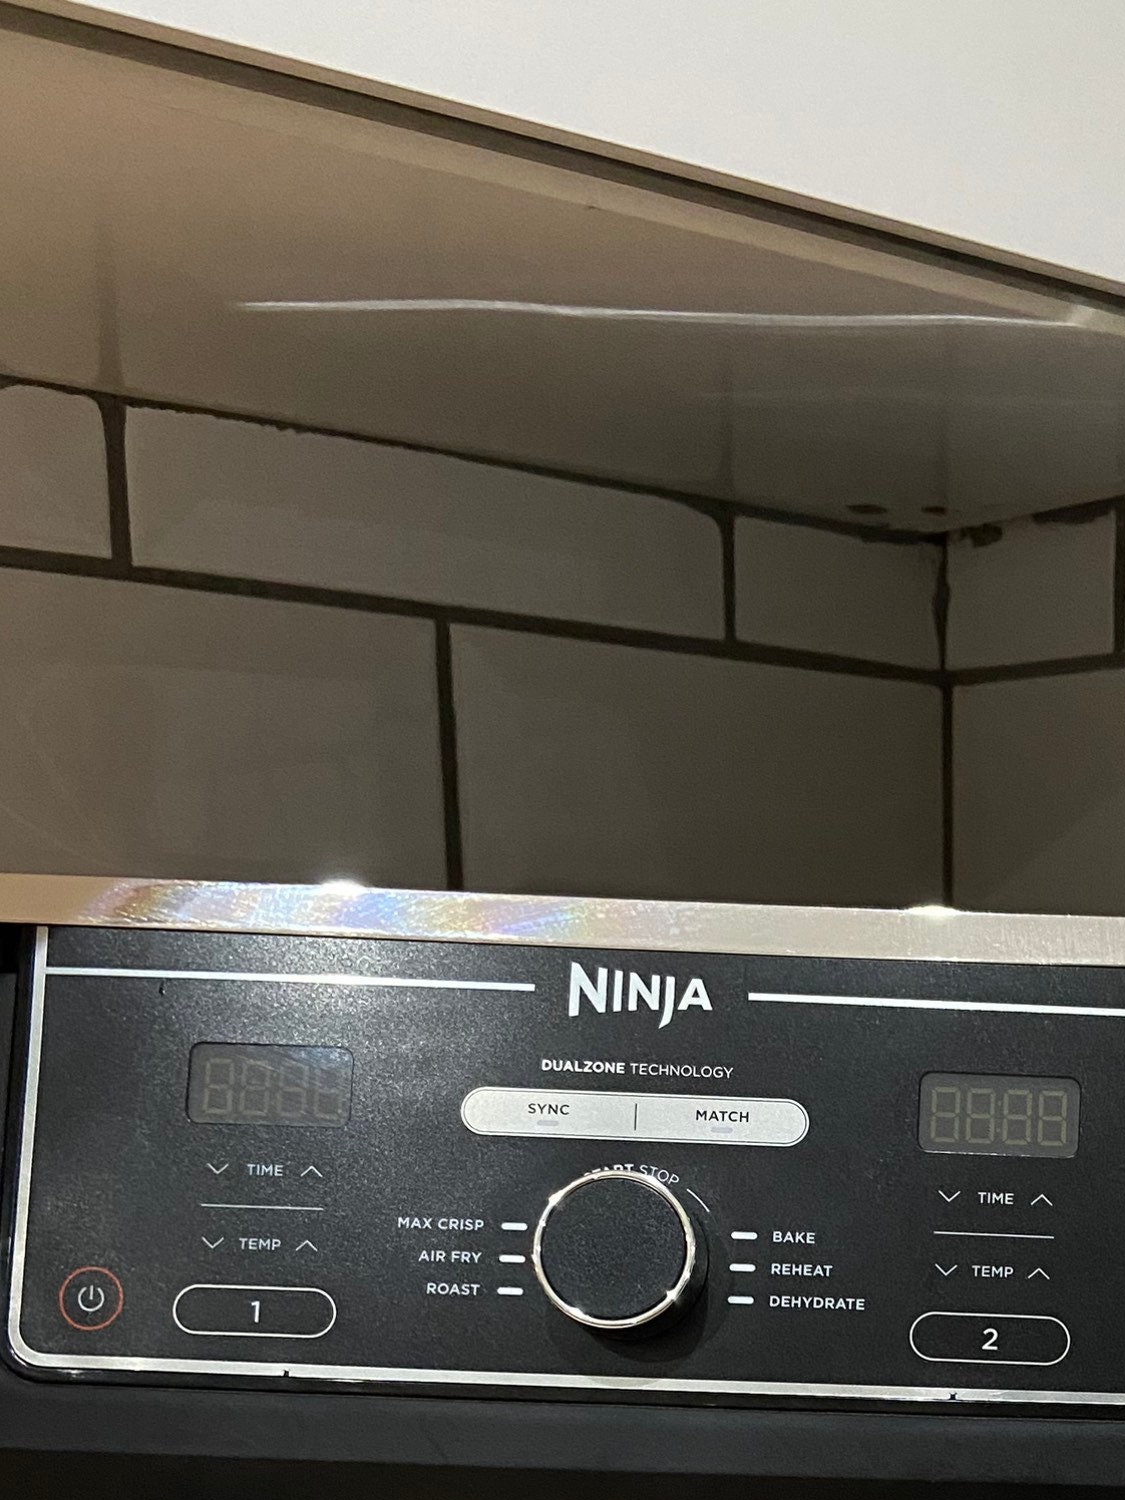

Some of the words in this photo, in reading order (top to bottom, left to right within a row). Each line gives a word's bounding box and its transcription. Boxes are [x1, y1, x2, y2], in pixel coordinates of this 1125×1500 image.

[569, 961, 712, 1029] NINJA
[541, 1058, 626, 1074] DUALZONE
[629, 1062, 734, 1079] TECHNOLOGY
[527, 1102, 570, 1116] SYNC
[695, 1109, 750, 1123] MATCH
[246, 1163, 284, 1177] TIME
[639, 1164, 680, 1185] STOP
[977, 1191, 1015, 1205] TIME
[397, 1216, 433, 1230] MAX
[437, 1217, 484, 1231] CRISP
[238, 1237, 282, 1251] TEMP
[772, 1230, 816, 1244] BAKE
[418, 1249, 446, 1262] AIR
[451, 1250, 482, 1264] FRY
[770, 1262, 833, 1277] REHEAT
[971, 1265, 1014, 1278] TEMP
[426, 1282, 481, 1296] ROAST
[769, 1295, 866, 1311] DEHYDRATE
[250, 1300, 260, 1323] 1
[981, 1327, 998, 1351] 2
